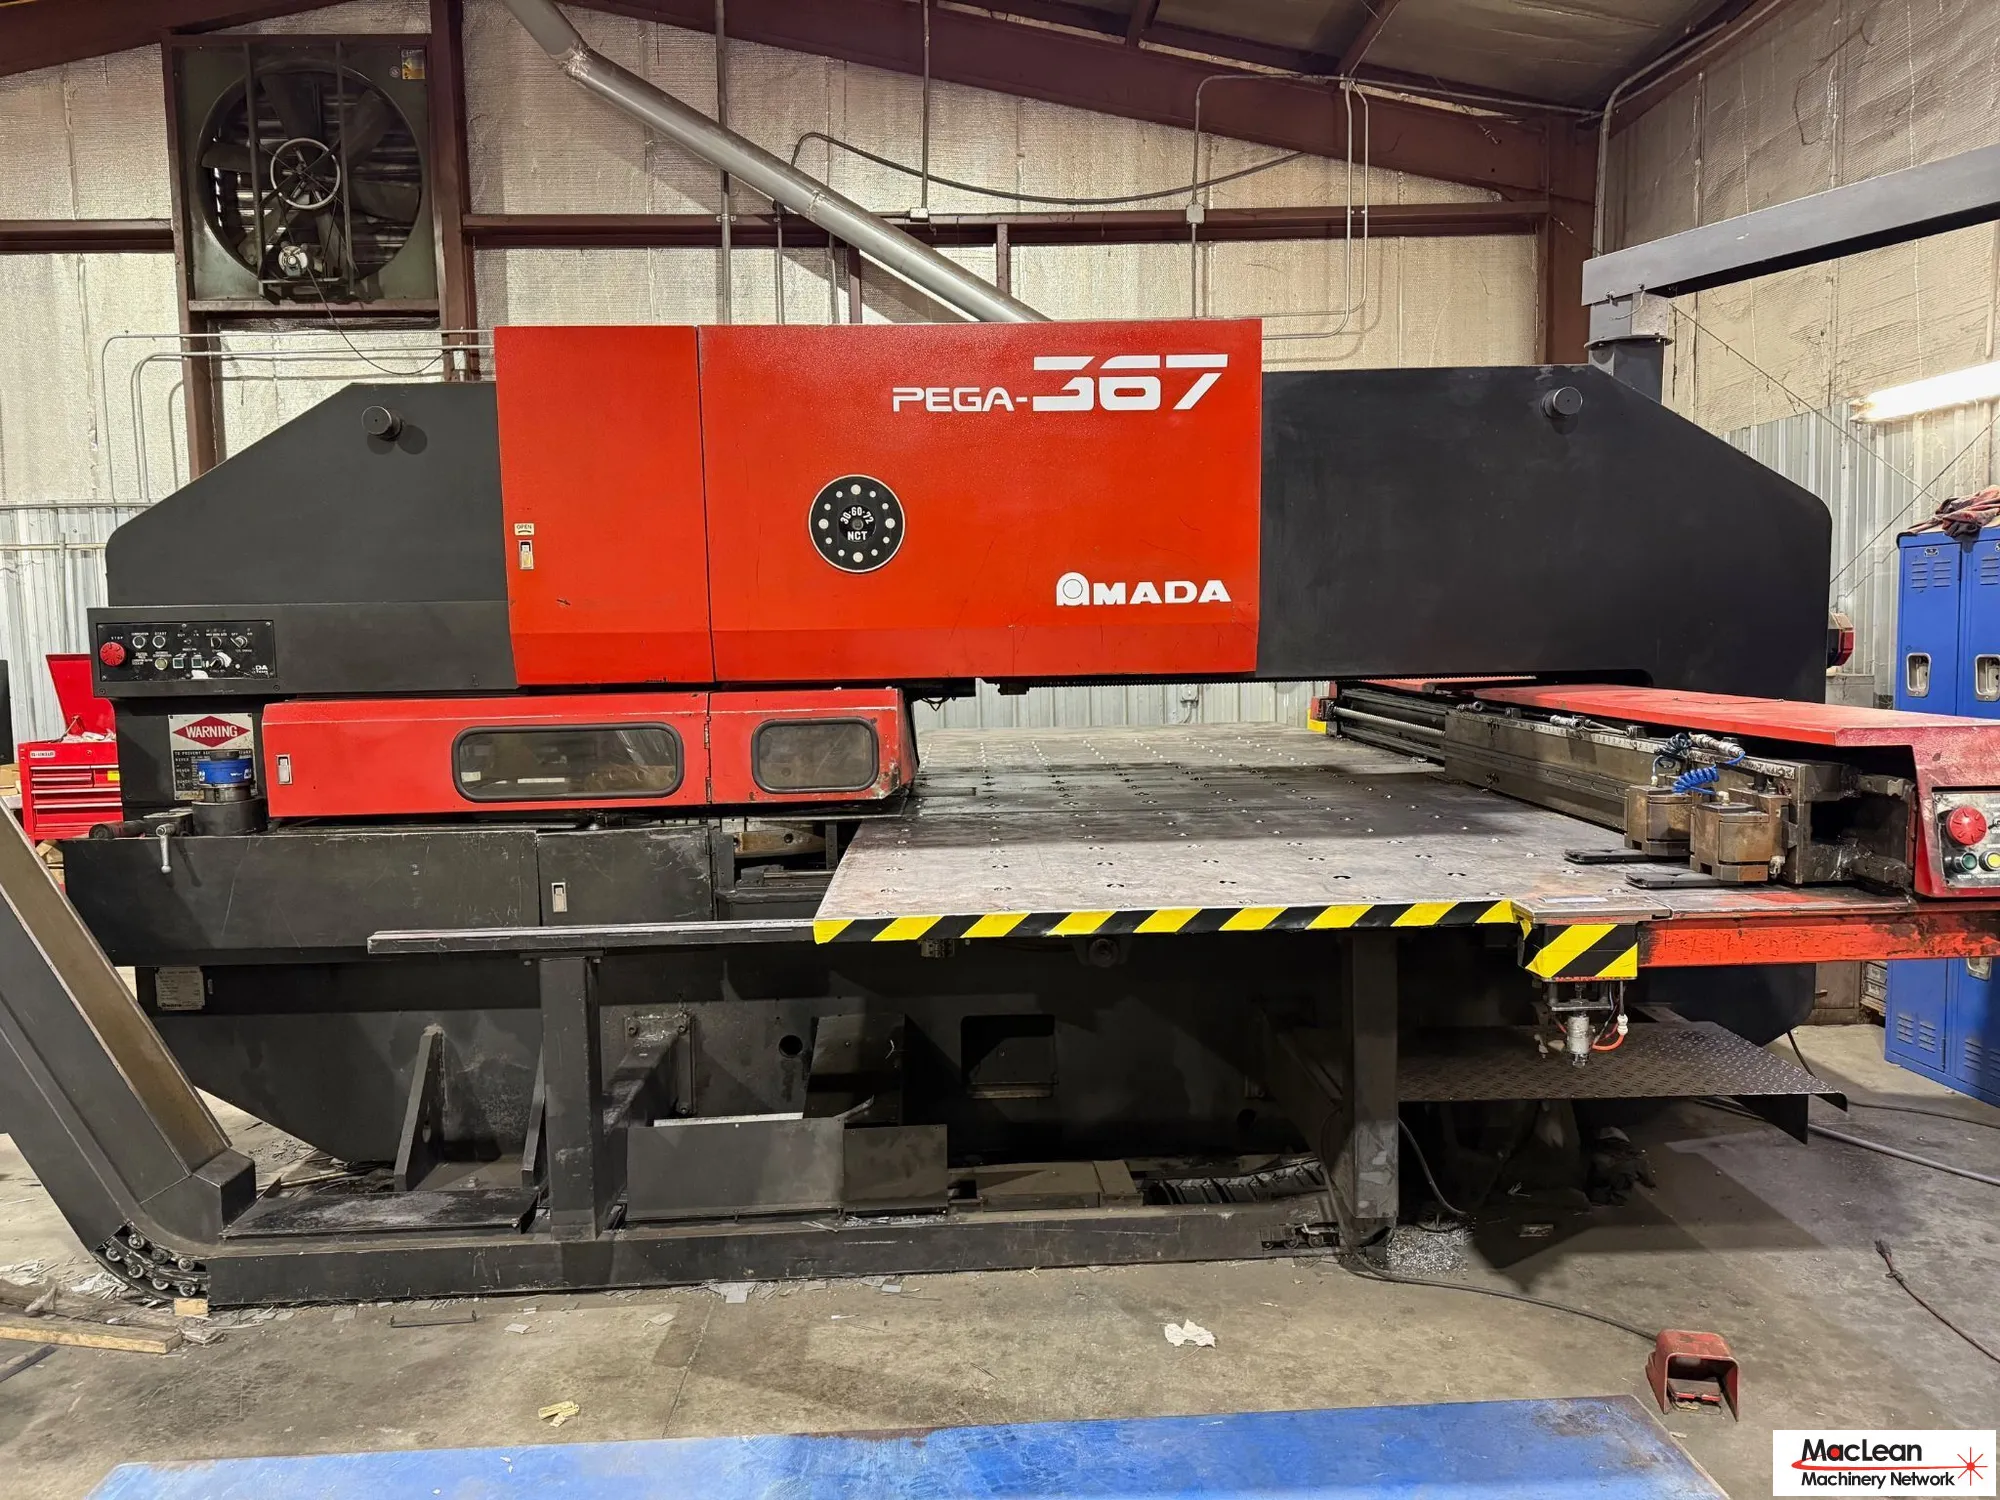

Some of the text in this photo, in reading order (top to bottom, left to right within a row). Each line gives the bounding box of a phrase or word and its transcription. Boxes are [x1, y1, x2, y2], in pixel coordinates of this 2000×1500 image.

[892, 353, 1228, 411] PEGA-367
[847, 530, 868, 541] NCT
[1056, 571, 1232, 606] AMADA
[185, 725, 238, 738] WARNING
